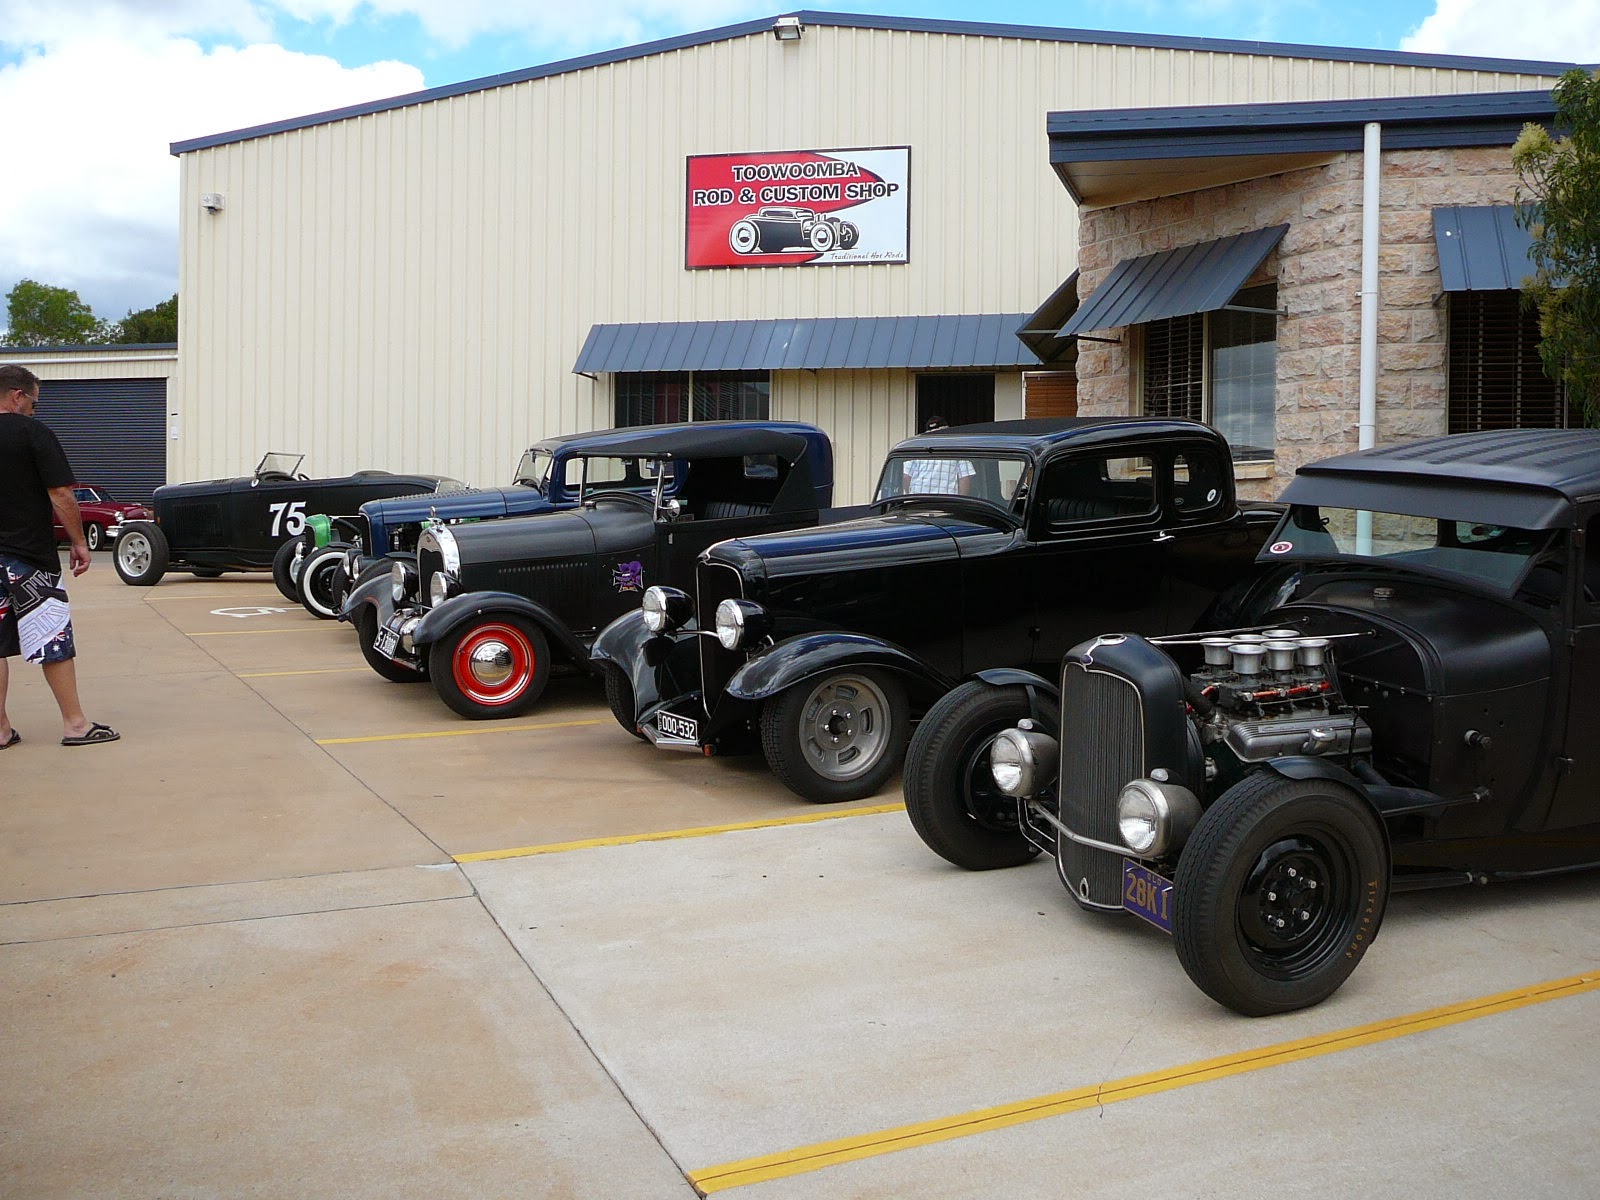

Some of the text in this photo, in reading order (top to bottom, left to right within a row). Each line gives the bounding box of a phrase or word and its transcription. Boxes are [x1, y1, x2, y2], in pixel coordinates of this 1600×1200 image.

[732, 161, 860, 181] TOOWOOMBA
[694, 182, 900, 205] ROD & CUSTOM SHOP
[831, 248, 903, 260] Traditional Hot Rods
[270, 501, 307, 537] 75
